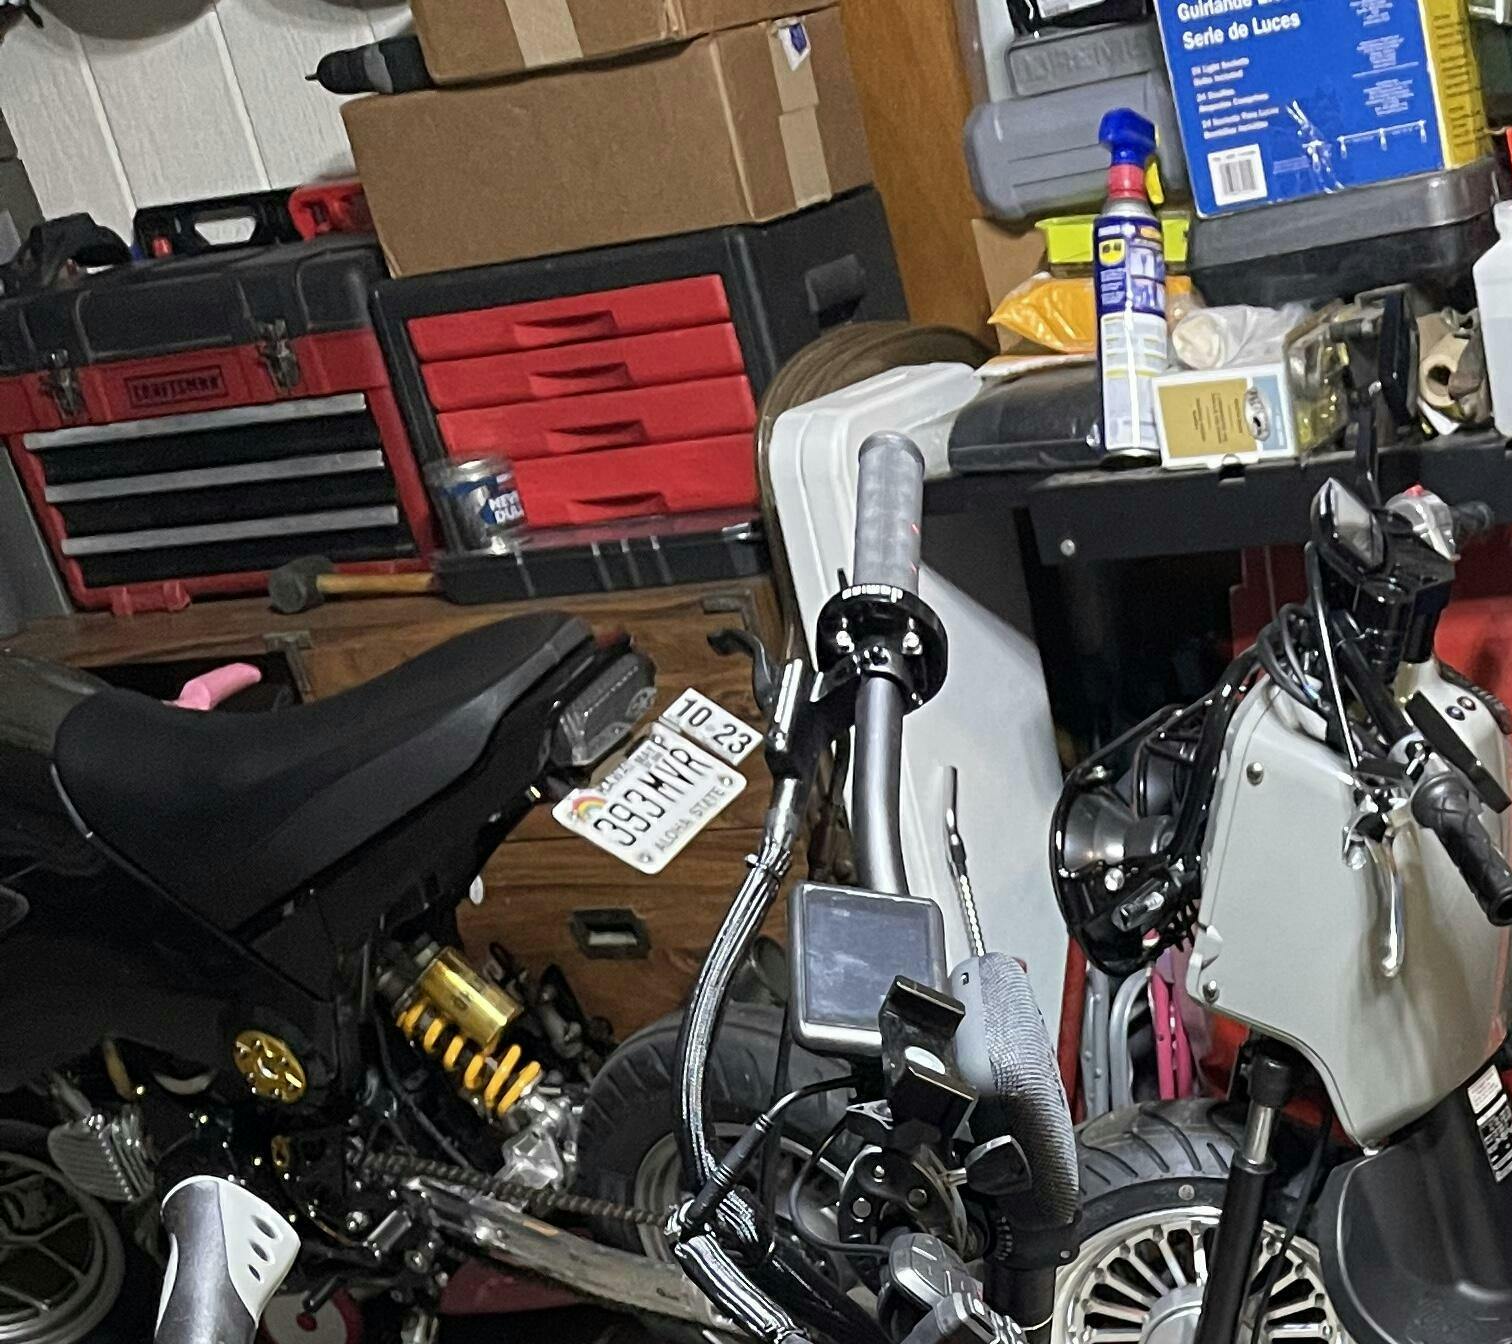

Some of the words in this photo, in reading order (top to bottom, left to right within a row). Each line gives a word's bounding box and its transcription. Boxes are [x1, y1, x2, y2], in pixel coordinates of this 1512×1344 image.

[1182, 25, 1225, 50] Serie
[1228, 21, 1249, 41] de
[1252, 12, 1301, 36] Luces
[676, 697, 712, 728] 10
[713, 723, 753, 755] 23
[655, 818, 690, 852] ALOHA
[689, 785, 726, 817] STATE
